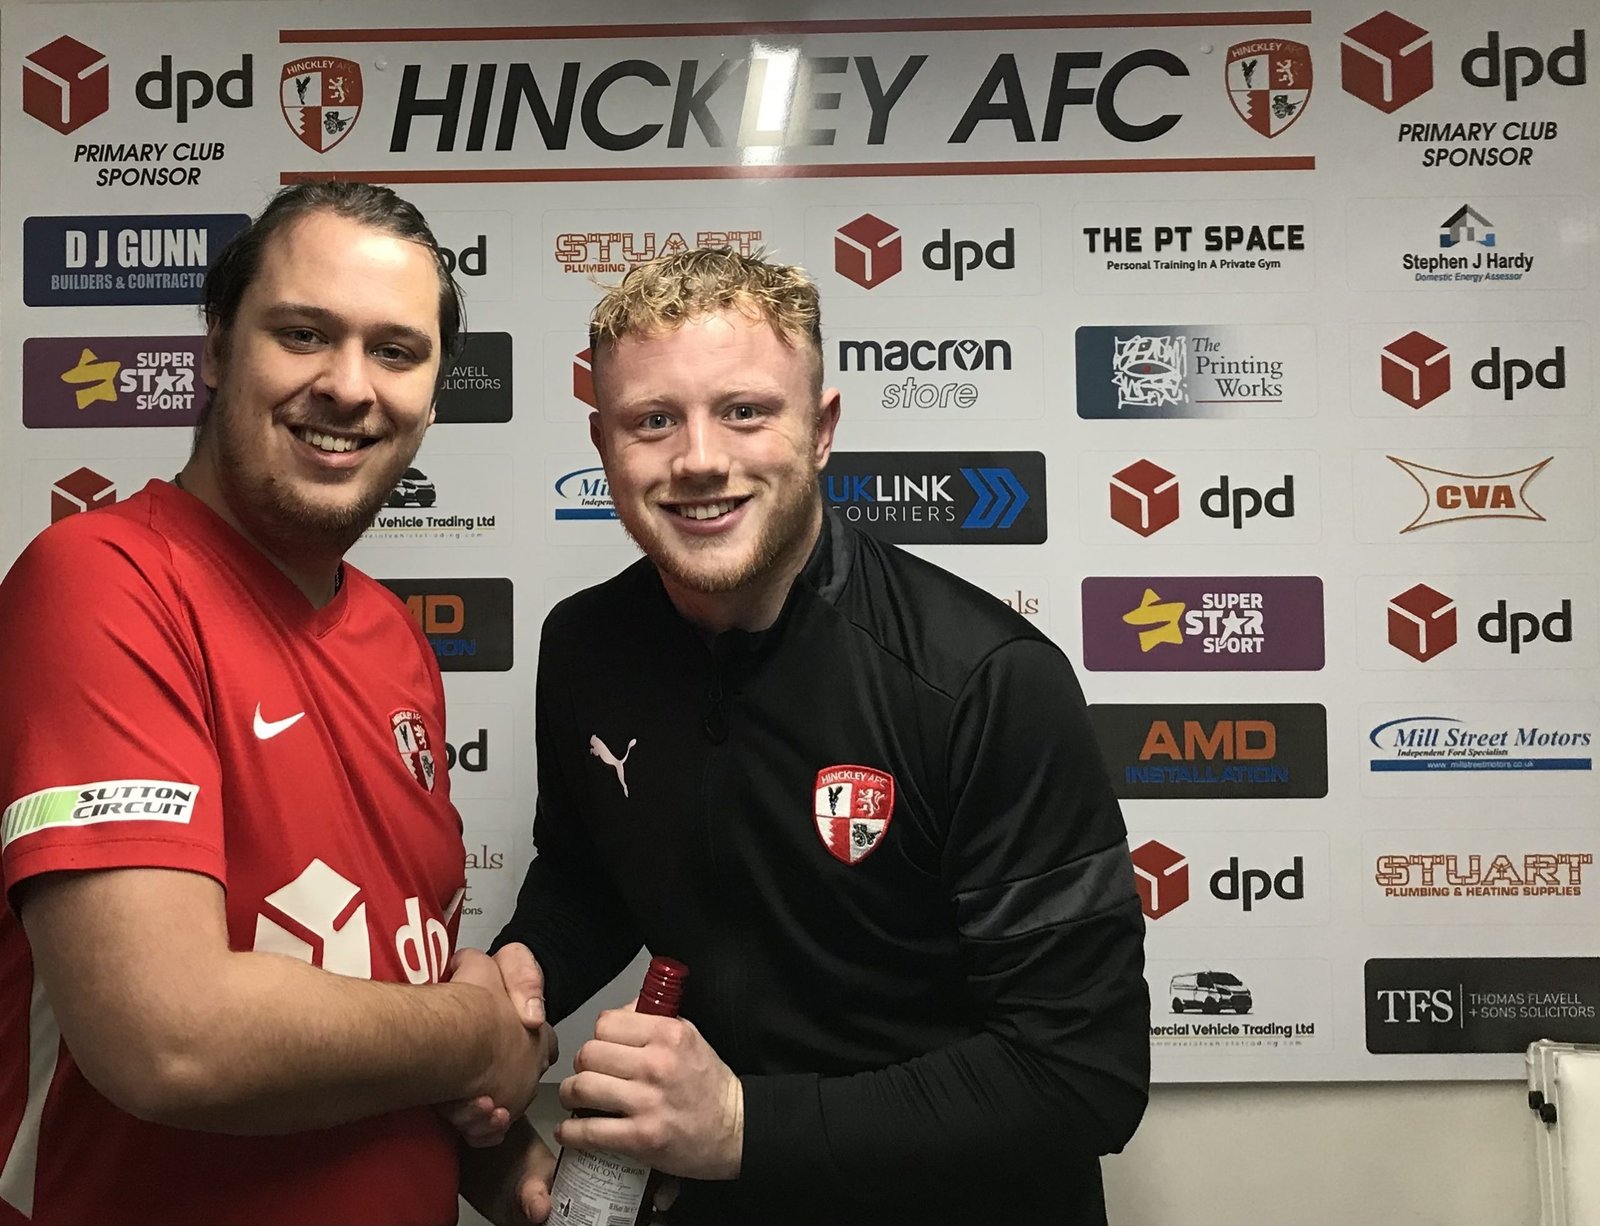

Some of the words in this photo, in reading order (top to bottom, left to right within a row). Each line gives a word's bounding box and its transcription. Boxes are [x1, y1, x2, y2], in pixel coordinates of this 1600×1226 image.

[1232, 42, 1282, 58] HINCKLEY
[287, 60, 335, 75] HINCKLEY
[1461, 30, 1587, 102] dpd
[135, 54, 253, 123] dpd
[389, 55, 928, 152] HINCKLEY
[947, 49, 1190, 144] AFC
[1398, 122, 1497, 142] PRIMARY
[1502, 121, 1558, 140] CLUB
[74, 143, 169, 162] PRIMARY
[173, 142, 225, 161] CLUB
[1422, 147, 1533, 167] SPONSOR
[96, 167, 201, 186] SPONSOR
[65, 230, 87, 268] D
[95, 229, 108, 268] J
[117, 228, 208, 268] GUNN
[1083, 227, 1142, 253] THE
[1155, 226, 1192, 251] PT
[1204, 225, 1304, 251] SPACE
[921, 228, 1015, 281] dpd
[1402, 253, 1468, 273] Stephen
[1472, 253, 1481, 269] J
[1486, 252, 1534, 272] Hardy
[564, 264, 625, 274] PLUMBING
[1107, 260, 1151, 270] Personal
[1153, 260, 1195, 271] Training
[1210, 260, 1217, 269] A
[1220, 259, 1256, 269] Private
[1258, 259, 1281, 270] Gym
[51, 274, 112, 290] BUILDERS
[115, 276, 125, 289] &
[127, 272, 205, 289] CONTRACTO
[1415, 272, 1453, 281] Domestic
[1455, 272, 1483, 283] Energy
[1485, 272, 1522, 281] Assessor
[1192, 337, 1221, 352] The
[136, 352, 195, 367] SUPER
[839, 339, 1012, 371] macron
[446, 366, 488, 377] AVELL
[1195, 355, 1283, 379] Printing
[1471, 346, 1566, 400] dpd
[882, 377, 978, 408] store
[1215, 377, 1283, 397] Works
[136, 394, 195, 410] SPORT
[1199, 475, 1295, 529] dpd
[1436, 485, 1516, 509] CVA
[378, 516, 423, 528] Vehicle
[426, 515, 474, 530] Trading
[477, 515, 495, 527] Ltd
[832, 506, 955, 522] OURIERS
[1202, 593, 1263, 610] SUPER
[1477, 599, 1572, 654] dpd
[1203, 637, 1264, 653] SPORT
[1139, 720, 1276, 760] AMD
[1393, 728, 1439, 747] Mill
[1444, 728, 1508, 747] Street
[1514, 727, 1591, 746] Motors
[1397, 748, 1445, 758] Independent
[1447, 748, 1466, 756] Ford
[821, 771, 866, 784] HINCKLEY
[868, 774, 888, 787] AFC
[1125, 765, 1290, 784] INSTALLATION
[78, 786, 191, 803] SUTTON
[73, 802, 187, 819] CIRCUIT
[1375, 853, 1592, 886] STUART
[1209, 856, 1304, 911] dpd
[1385, 887, 1449, 897] PLUMBING
[1453, 887, 1462, 896] &
[1466, 887, 1518, 896] HEATING
[1523, 886, 1581, 896] SUPPLIES
[1377, 989, 1454, 1023] TFS
[1469, 993, 1525, 1005] THOMAS
[1528, 993, 1582, 1005] FLAVELL
[1481, 1007, 1517, 1018] SONS
[1519, 1006, 1596, 1018] SOLICITORS
[1150, 1023, 1189, 1035] ercial
[1192, 1023, 1239, 1035] Vehicle
[1242, 1022, 1293, 1038] Trading
[1295, 1022, 1314, 1035] Ltd
